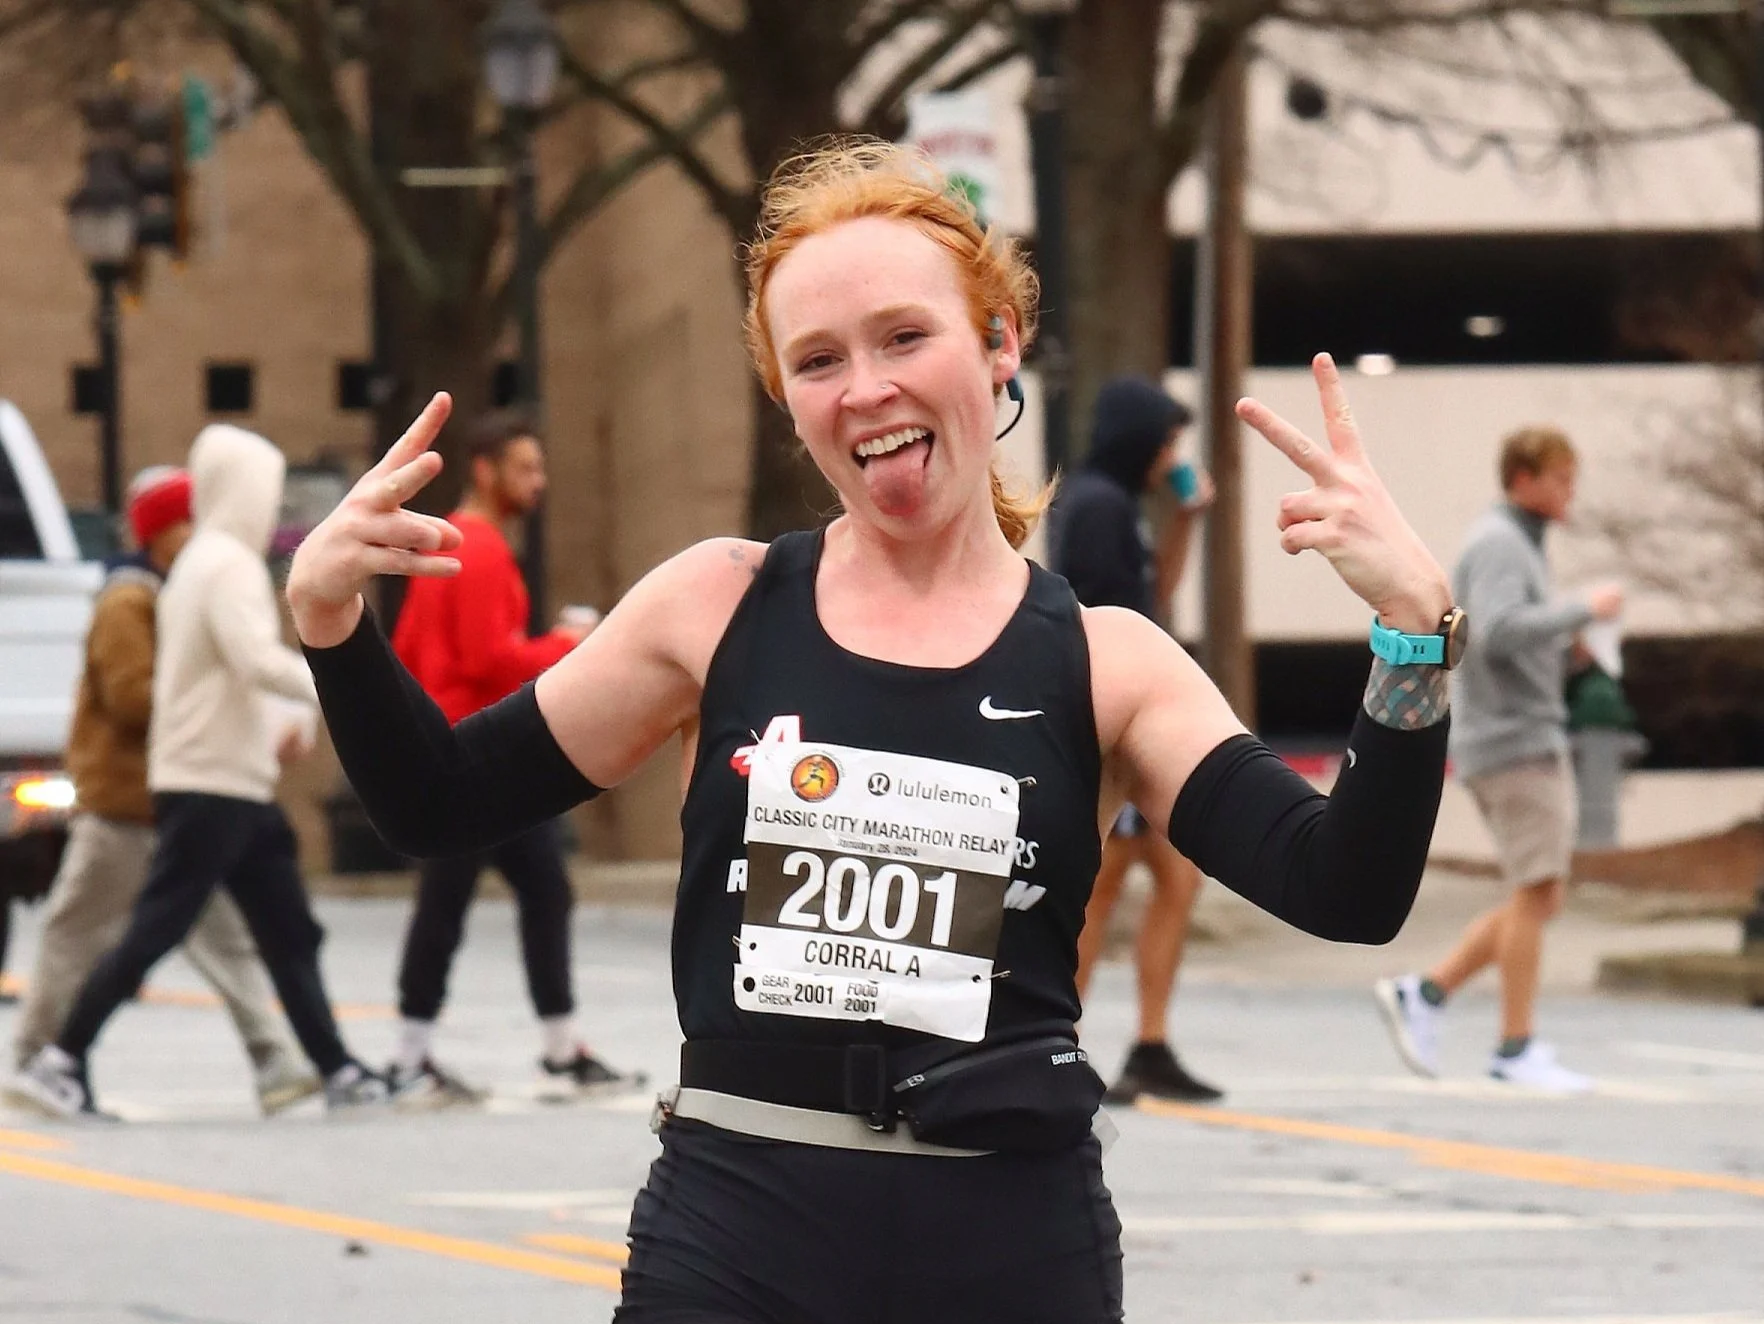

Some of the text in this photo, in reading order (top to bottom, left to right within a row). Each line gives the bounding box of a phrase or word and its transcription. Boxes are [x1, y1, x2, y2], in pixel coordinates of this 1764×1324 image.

[898, 778, 993, 808] lululemon
[754, 806, 1009, 855] CLASSIC CITY MARATHON RELAY
[777, 851, 958, 947] 2001
[804, 940, 921, 978] CORRAL A
[762, 974, 790, 989] GEAR
[847, 983, 878, 998] FOOD
[758, 993, 793, 1006] CHECK
[794, 983, 834, 1005] 2001
[844, 998, 877, 1013] 2001
[1051, 1051, 1076, 1065] BANDIT
